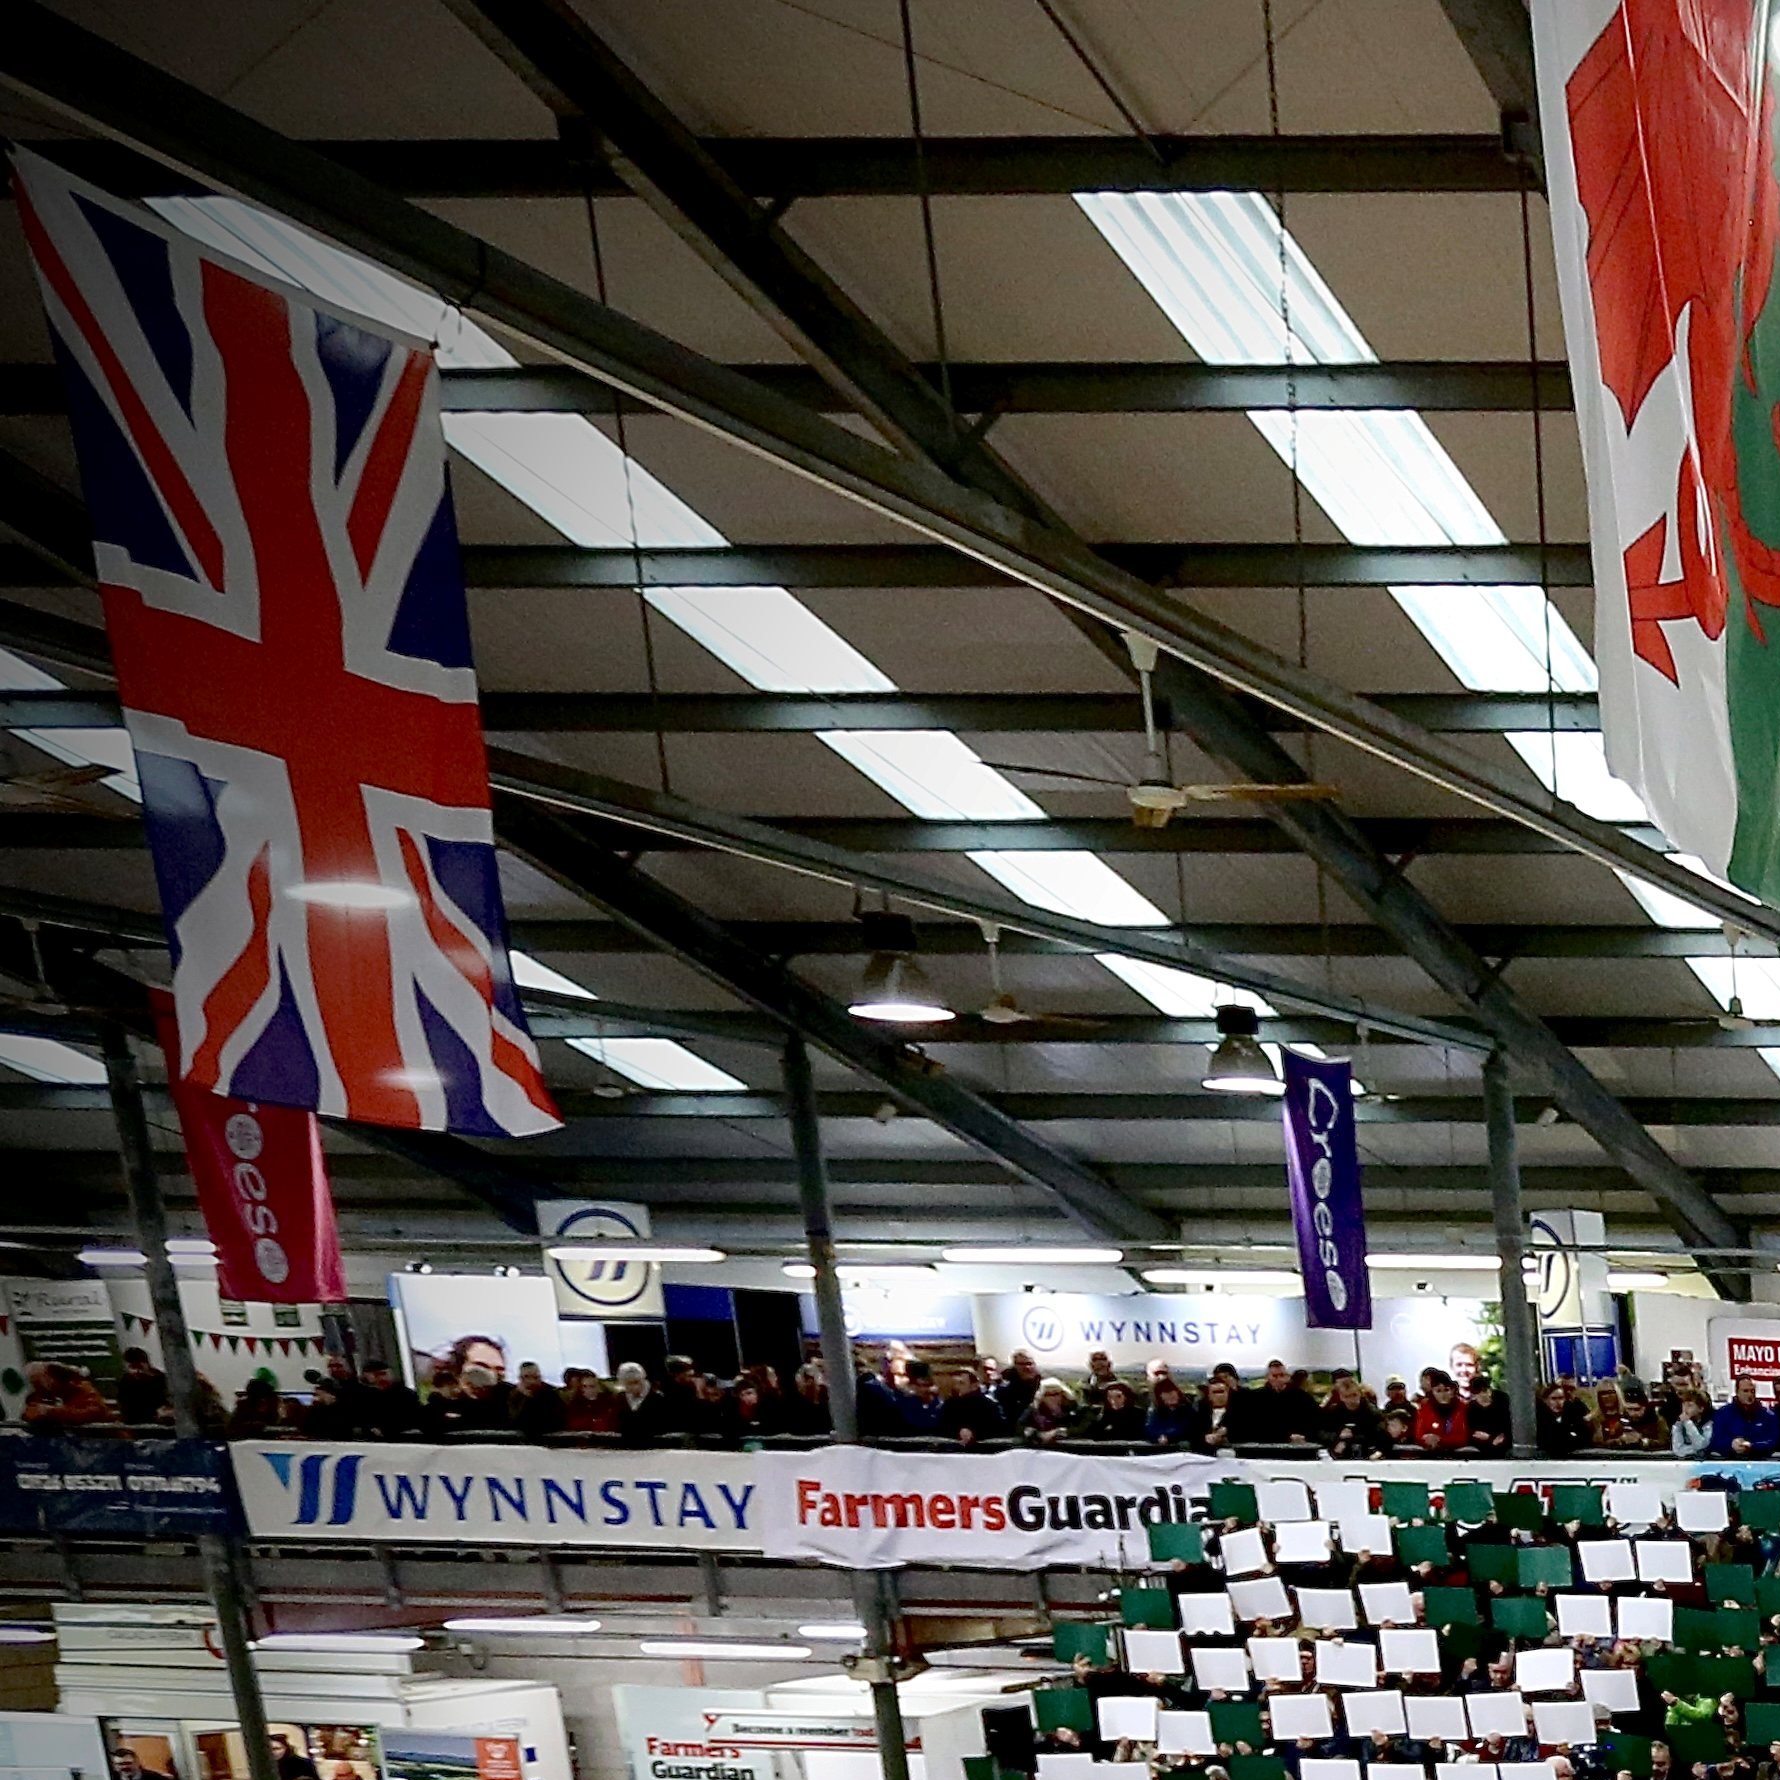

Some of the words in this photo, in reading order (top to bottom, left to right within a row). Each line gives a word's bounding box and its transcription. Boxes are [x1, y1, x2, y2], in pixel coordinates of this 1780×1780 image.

[1306, 1076, 1347, 1313] Croeso
[1079, 1319, 1264, 1347] WYNNSTAY
[1733, 1344, 1774, 1361] MAYO
[375, 1468, 759, 1532] WYNNSTAY
[797, 1480, 1213, 1534] FarmersGuardia
[646, 1737, 741, 1758] Farmers
[651, 1760, 755, 1780] Guardian
